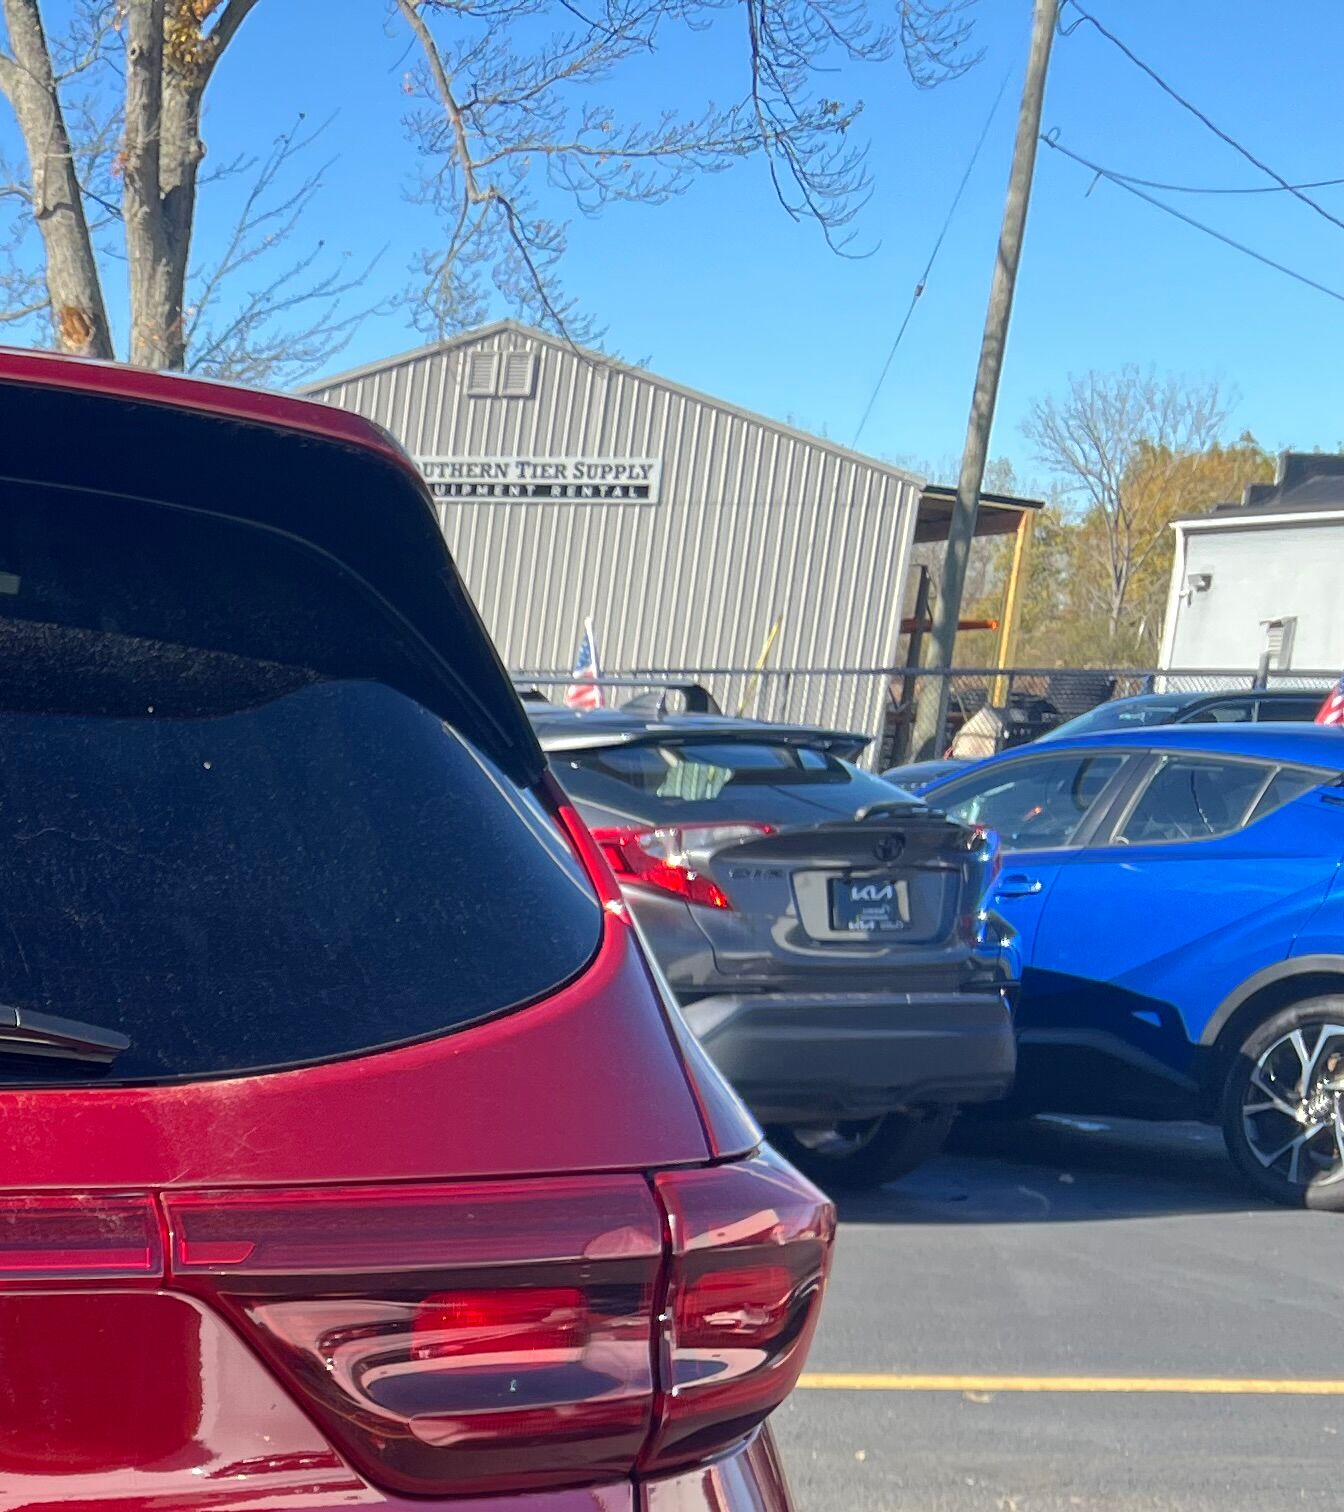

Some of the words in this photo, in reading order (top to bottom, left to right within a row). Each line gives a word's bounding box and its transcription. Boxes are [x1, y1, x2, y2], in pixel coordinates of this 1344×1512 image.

[418, 462, 509, 479] UTHERN
[515, 461, 567, 479] TIER
[572, 461, 653, 480] SUPPLY
[433, 483, 536, 497] UIPMENT
[550, 485, 639, 498] RENTAL
[851, 886, 893, 901] KIA
